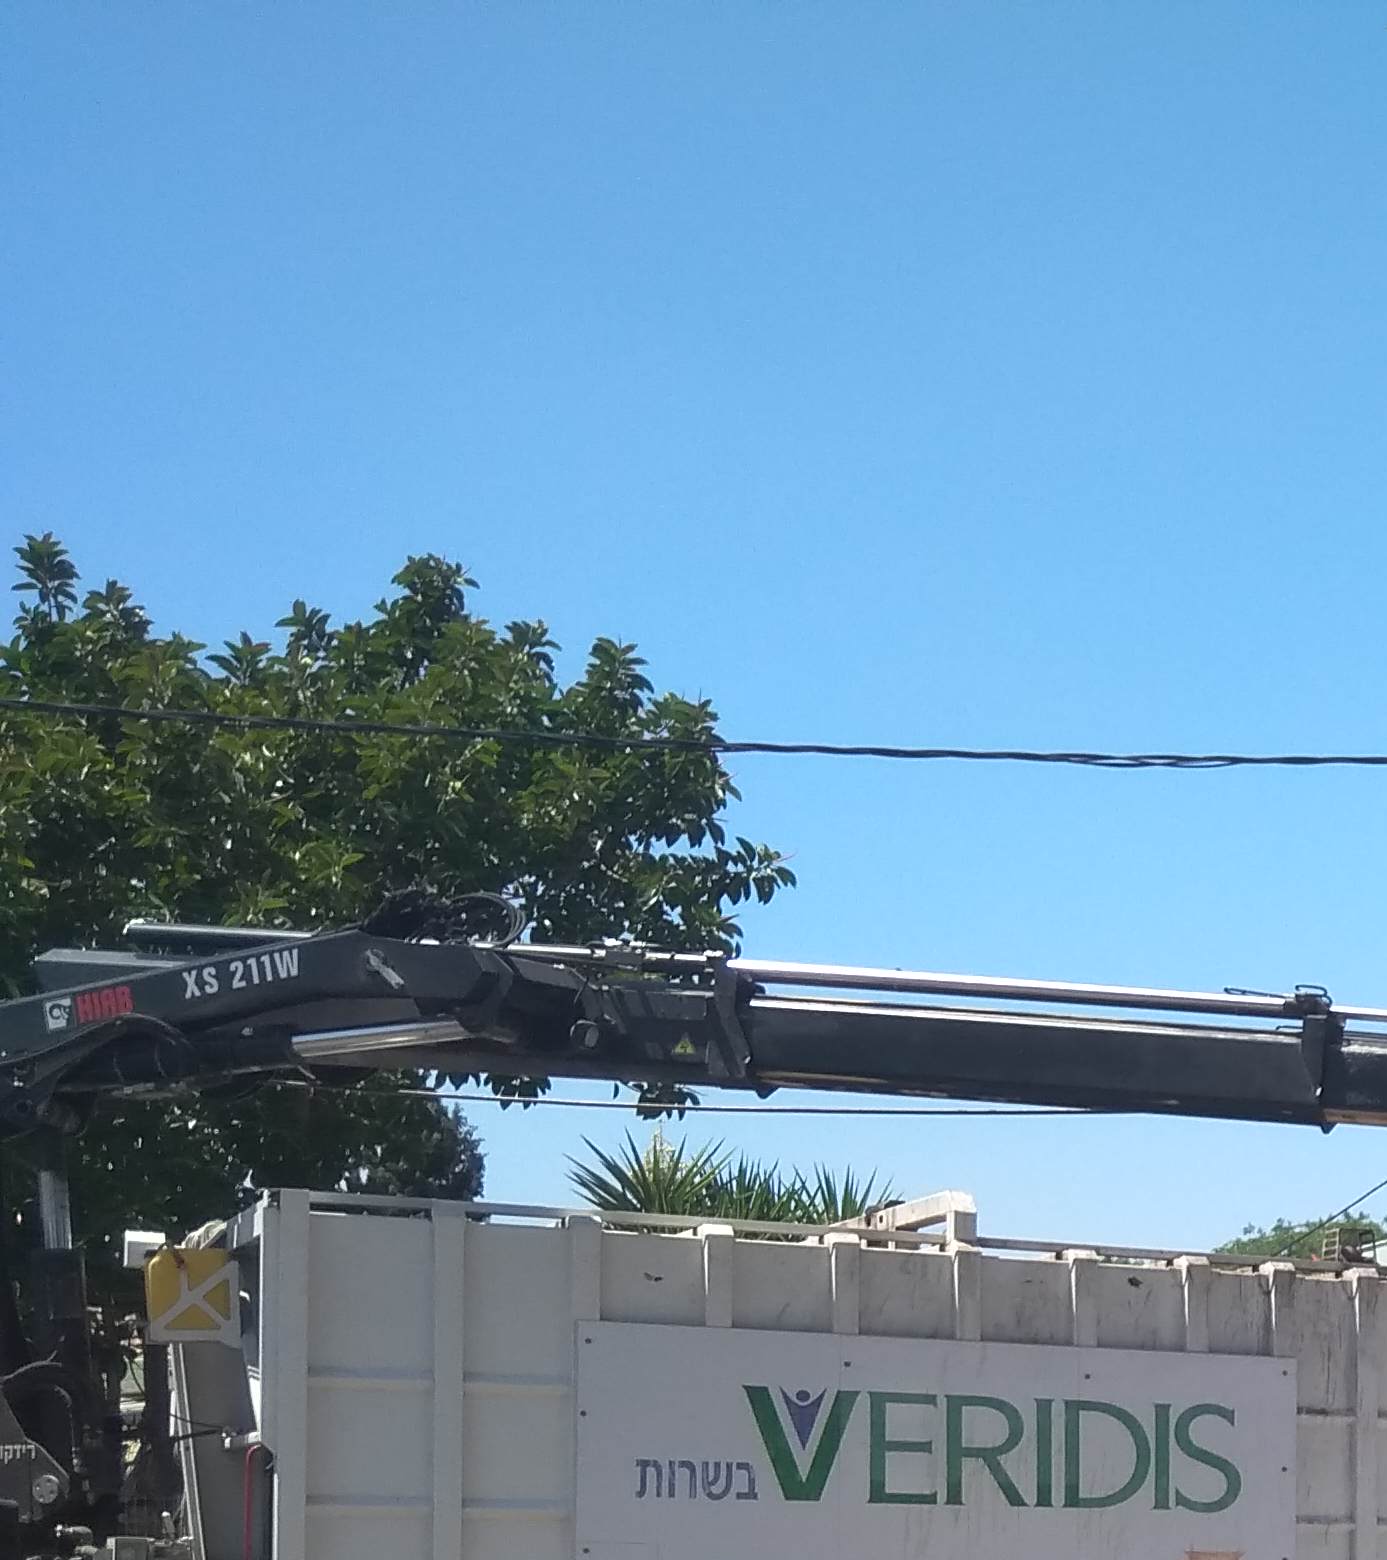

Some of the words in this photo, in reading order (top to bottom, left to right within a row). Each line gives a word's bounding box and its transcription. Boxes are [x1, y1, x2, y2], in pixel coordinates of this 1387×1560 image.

[182, 966, 219, 999] XS
[230, 948, 299, 989] 211W
[76, 985, 133, 1024] HIAB
[743, 1384, 1242, 1513] VERIDIS
[635, 1456, 758, 1500] בשרות
